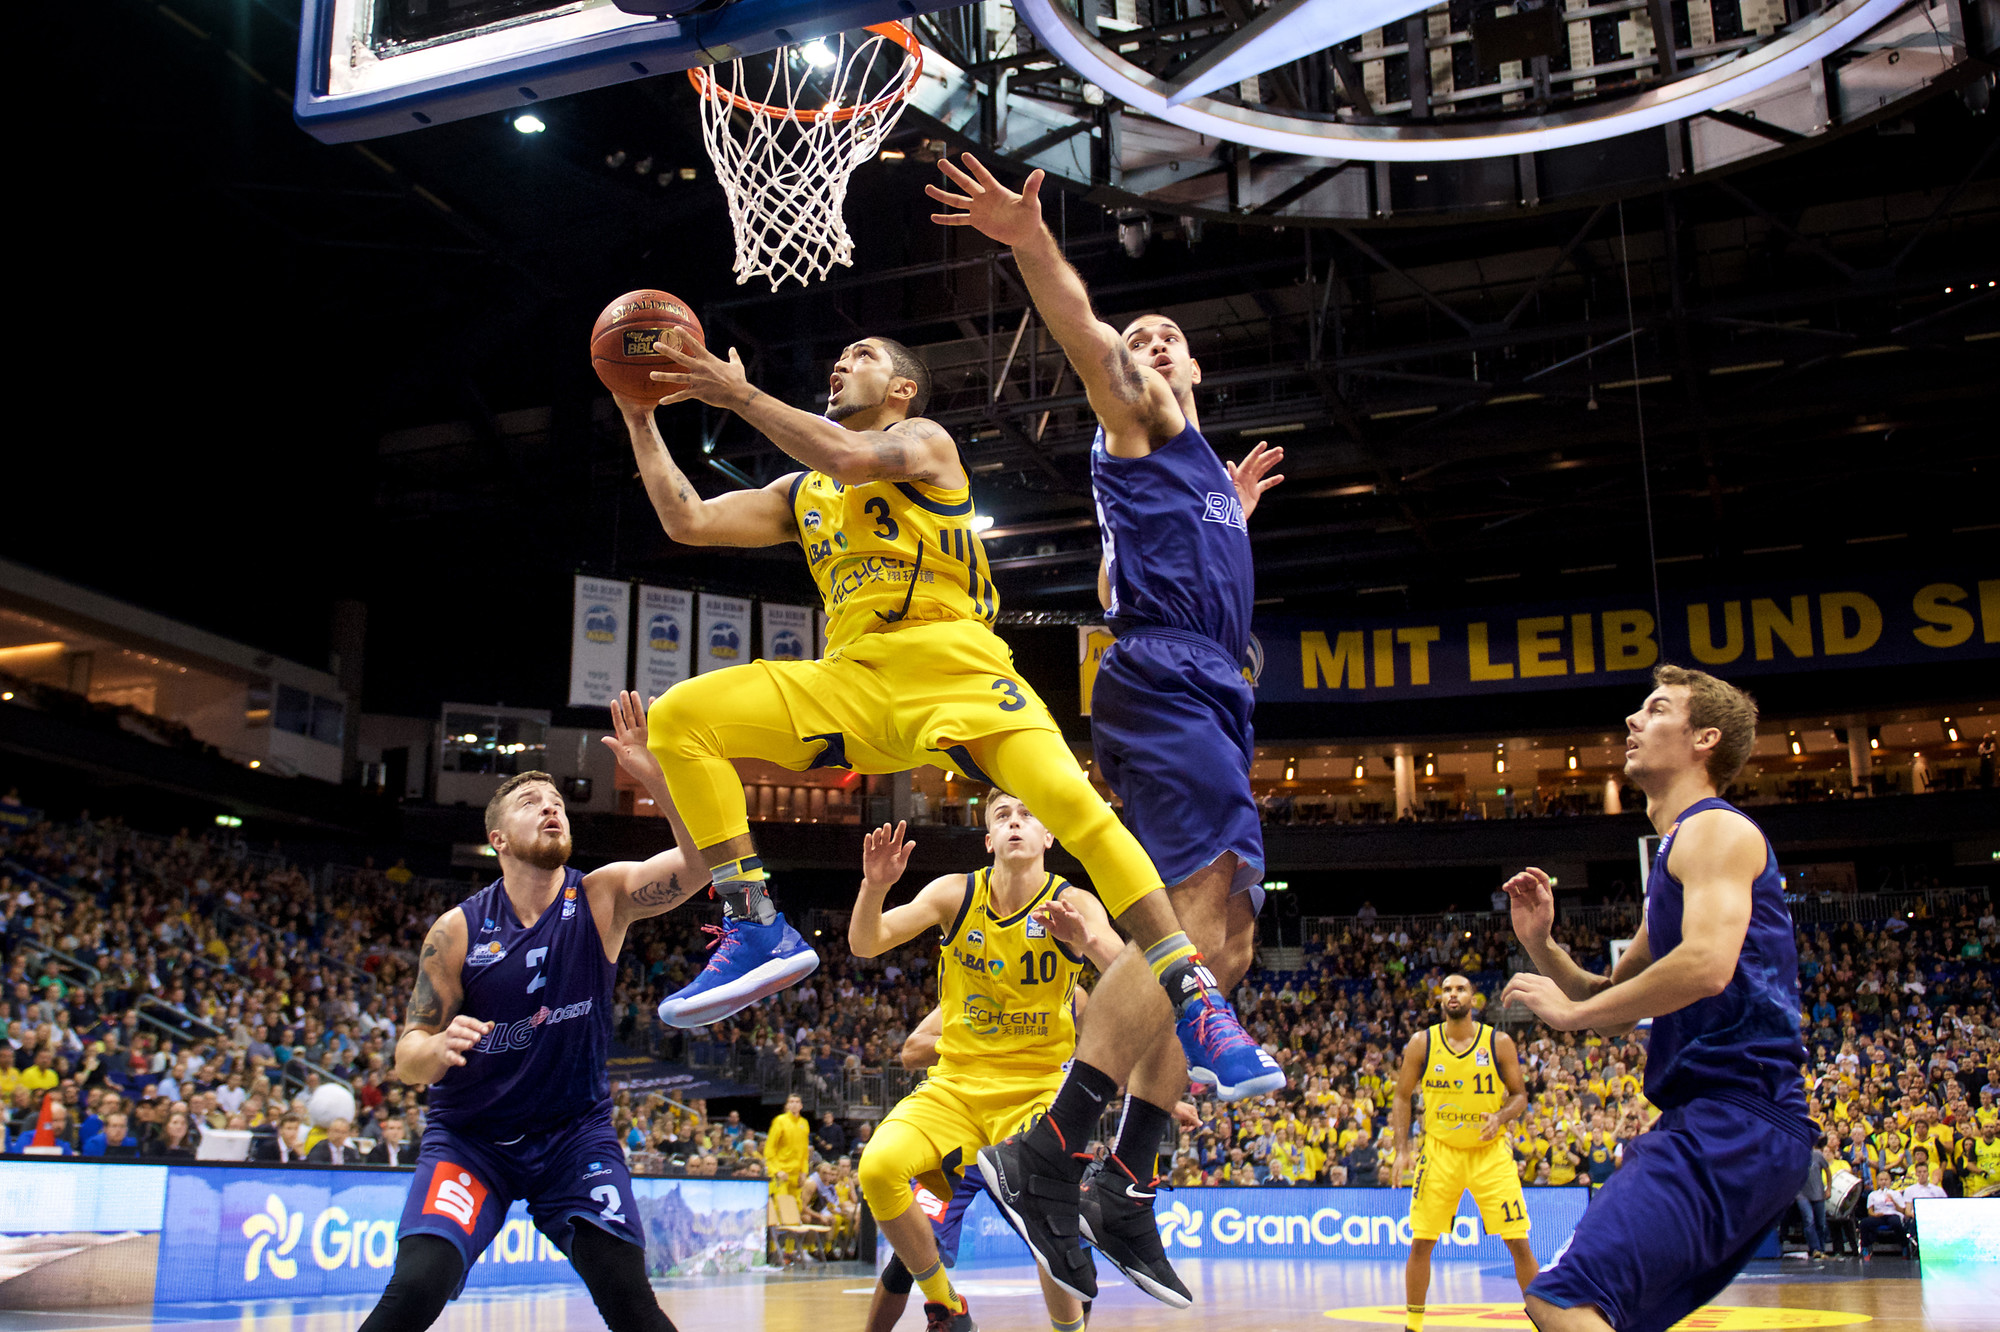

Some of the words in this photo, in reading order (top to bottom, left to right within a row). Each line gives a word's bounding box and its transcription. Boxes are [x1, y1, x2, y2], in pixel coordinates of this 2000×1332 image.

[611, 299, 691, 324] SPALDING
[627, 342, 654, 355] BBL
[864, 496, 900, 542] 3
[1202, 491, 1248, 536] BL
[808, 538, 833, 567] LBA
[1300, 626, 1440, 690] MIT
[1467, 609, 1659, 682] LEIB
[1687, 592, 1884, 665] UND
[992, 679, 1027, 712] 3
[1020, 950, 1058, 985] 10
[962, 1000, 1051, 1026] TECHCENT
[1425, 1079, 1451, 1089] ALBA
[1473, 1072, 1496, 1095] 11
[1435, 1111, 1484, 1122] TECHCE
[589, 1184, 626, 1225] 2
[1501, 1199, 1525, 1224] 11
